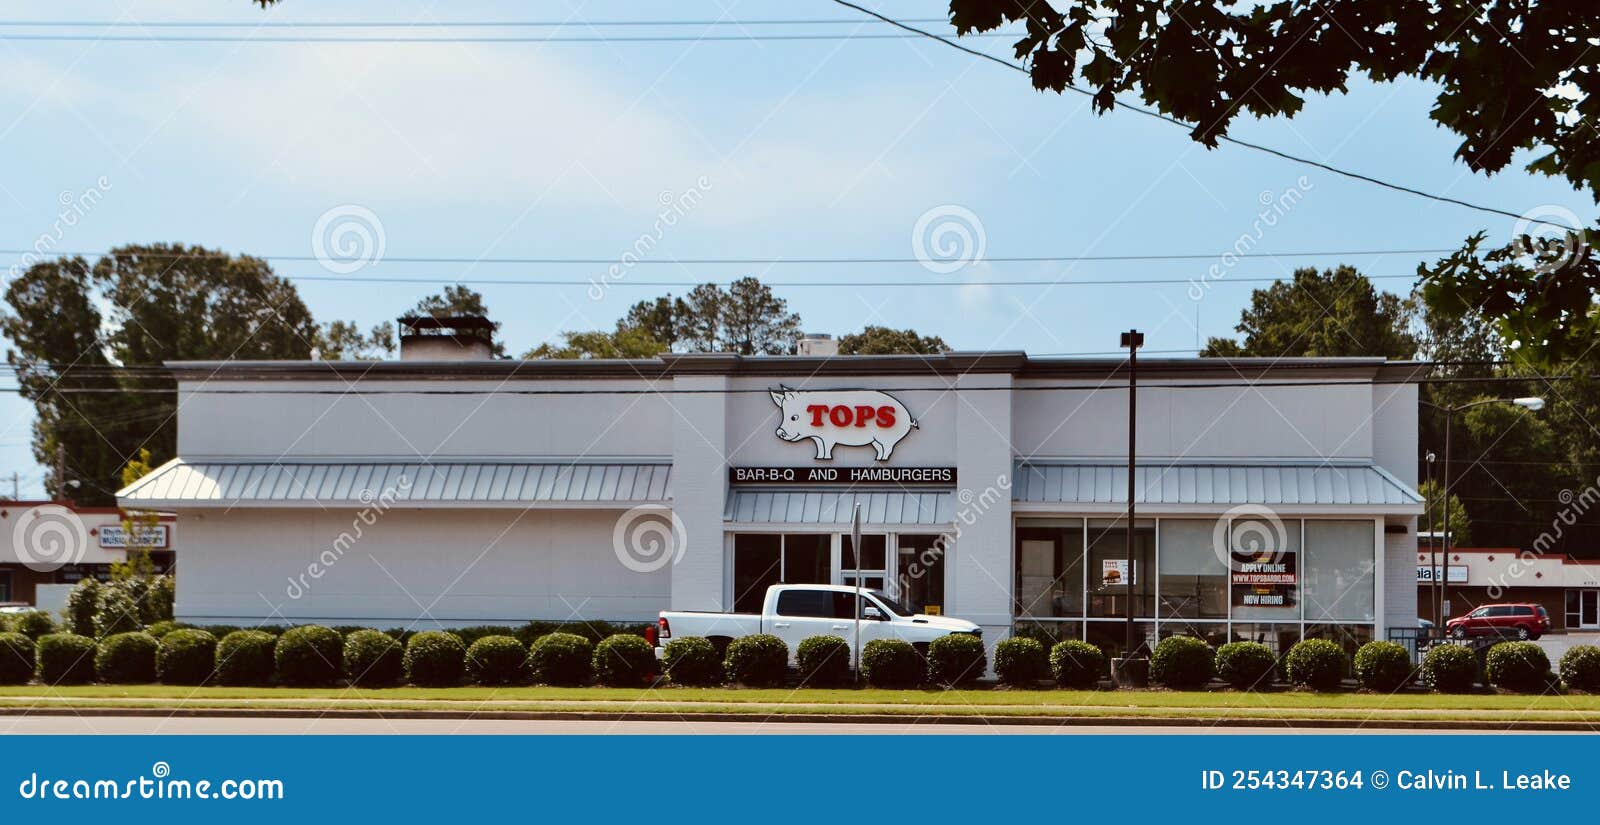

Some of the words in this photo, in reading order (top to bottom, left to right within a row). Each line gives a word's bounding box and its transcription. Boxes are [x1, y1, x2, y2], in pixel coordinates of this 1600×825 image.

[806, 404, 896, 428] TOPS
[736, 468, 795, 481] BAR-B-Q
[808, 468, 838, 481] AND
[850, 468, 952, 481] HAMBURGERS
[1241, 563, 1262, 573] APPLY
[1262, 563, 1286, 573] ONLINE
[1243, 595, 1260, 605] NOW
[1260, 595, 1283, 605] HIRING
